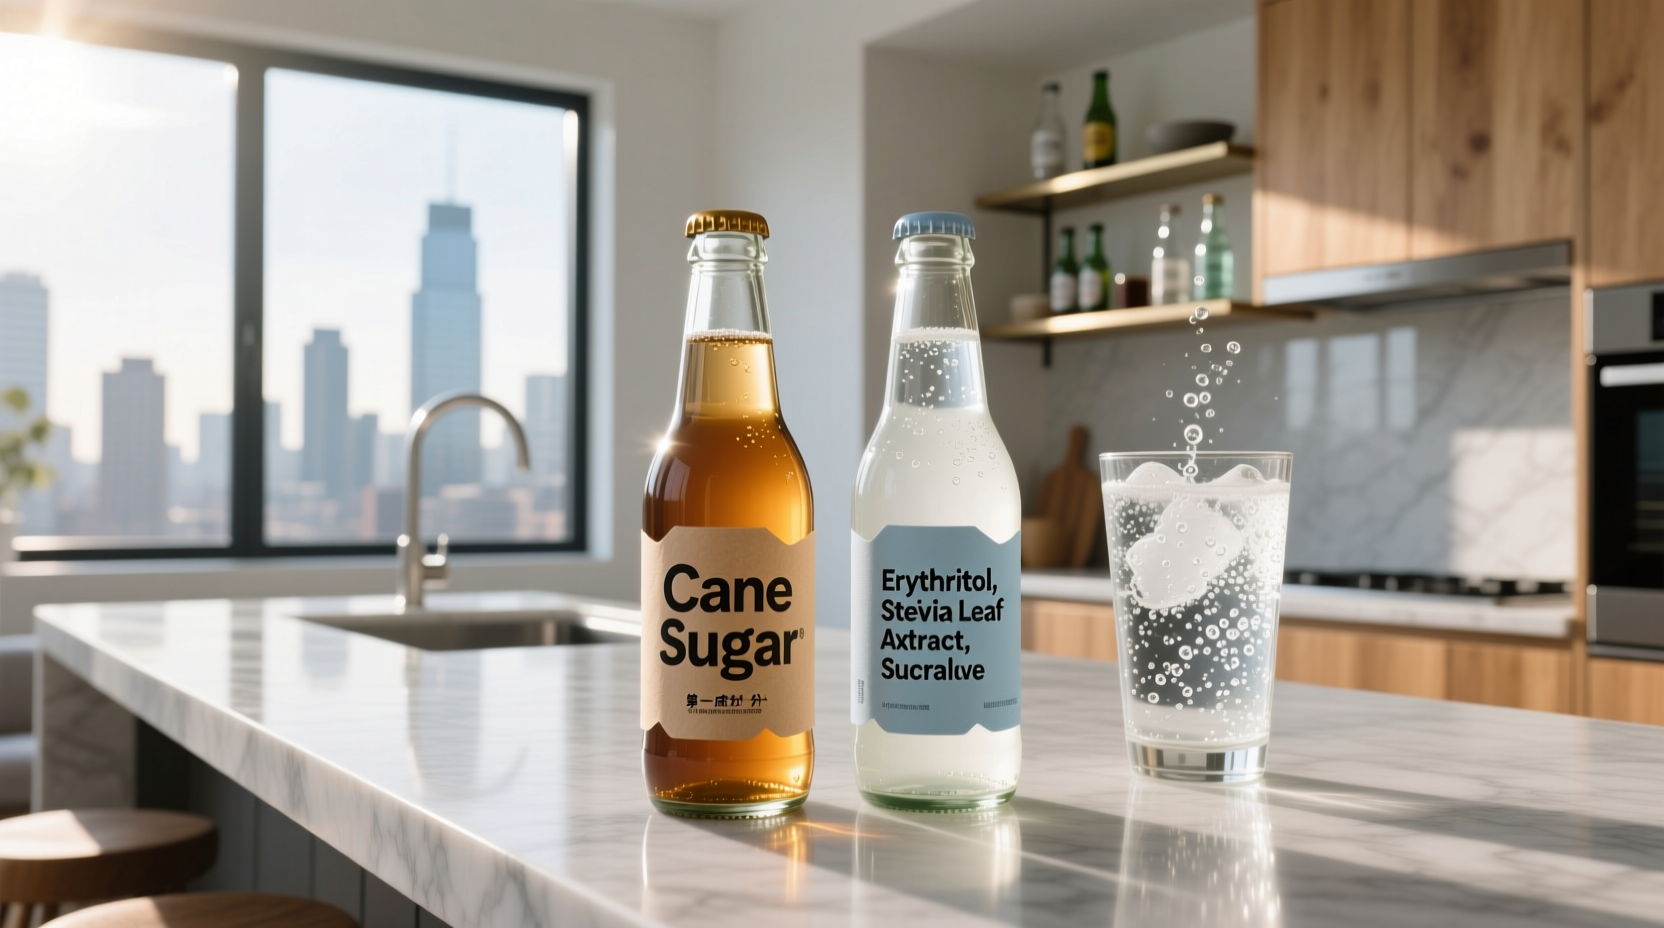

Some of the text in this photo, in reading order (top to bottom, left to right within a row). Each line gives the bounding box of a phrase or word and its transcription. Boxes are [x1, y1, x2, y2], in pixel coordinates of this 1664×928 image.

[663, 563, 793, 613] Cane
[881, 567, 998, 598] Erythritol,
[881, 597, 1004, 623] Stevia Leaf
[880, 628, 970, 655] Axtract,
